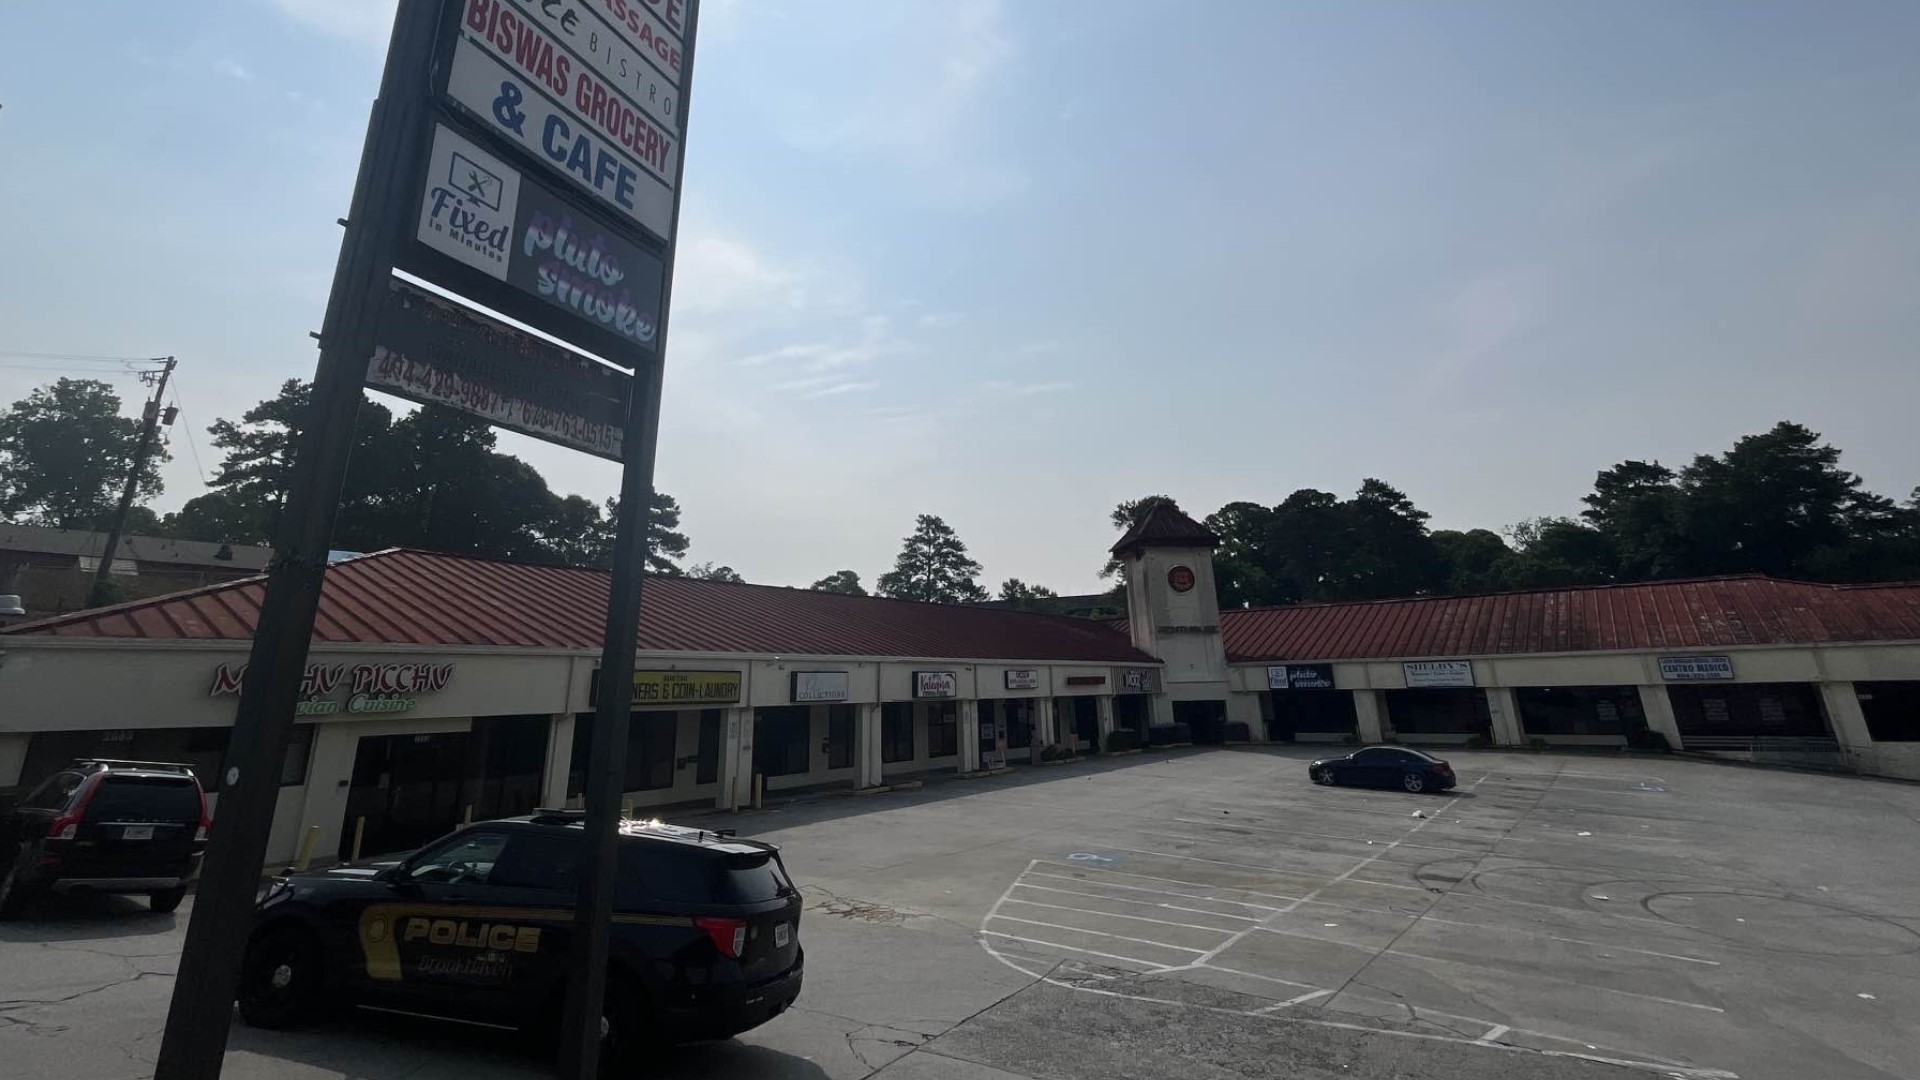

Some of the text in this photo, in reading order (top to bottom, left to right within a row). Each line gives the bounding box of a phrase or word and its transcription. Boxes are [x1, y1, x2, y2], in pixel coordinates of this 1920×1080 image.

[606, 0, 682, 72] SSAGE
[649, 0, 682, 31] E
[466, 0, 671, 174] BISWAS GROCERY
[590, 32, 672, 115] BISTRO
[492, 81, 637, 211] & CAFE
[429, 218, 442, 231] In
[431, 187, 509, 252] Fixed
[524, 211, 624, 286] pluto
[537, 261, 655, 342] smoke
[296, 693, 416, 715] vian Cuisine
[404, 917, 541, 952] POLICE
